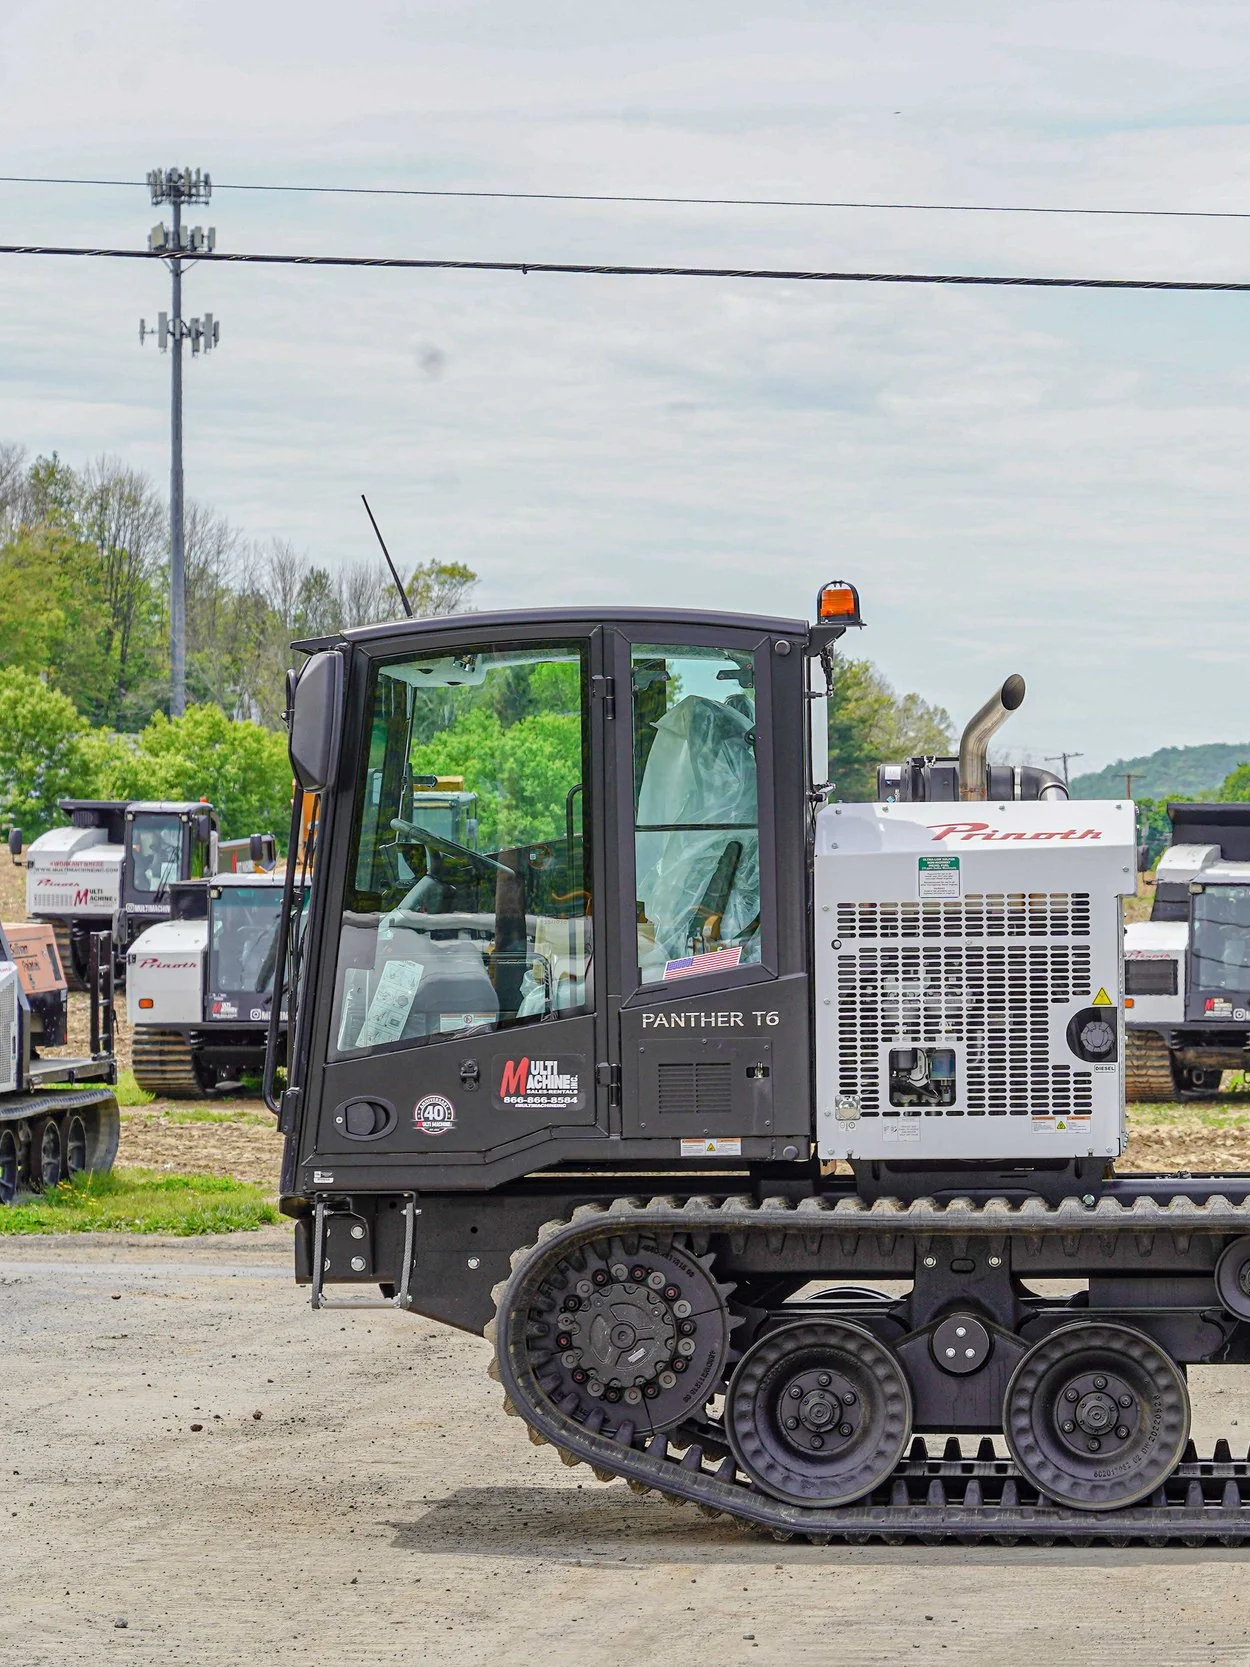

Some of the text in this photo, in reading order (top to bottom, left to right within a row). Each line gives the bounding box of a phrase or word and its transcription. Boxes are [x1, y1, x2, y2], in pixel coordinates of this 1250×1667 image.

[926, 822, 1103, 841] Prinoth
[134, 904, 171, 913] MULTIMACHIN
[139, 958, 198, 969] Prinoth
[641, 1011, 781, 1028] PANTHER T6
[503, 1096, 578, 1104] 866-866-8584
[423, 1105, 445, 1121] 40
